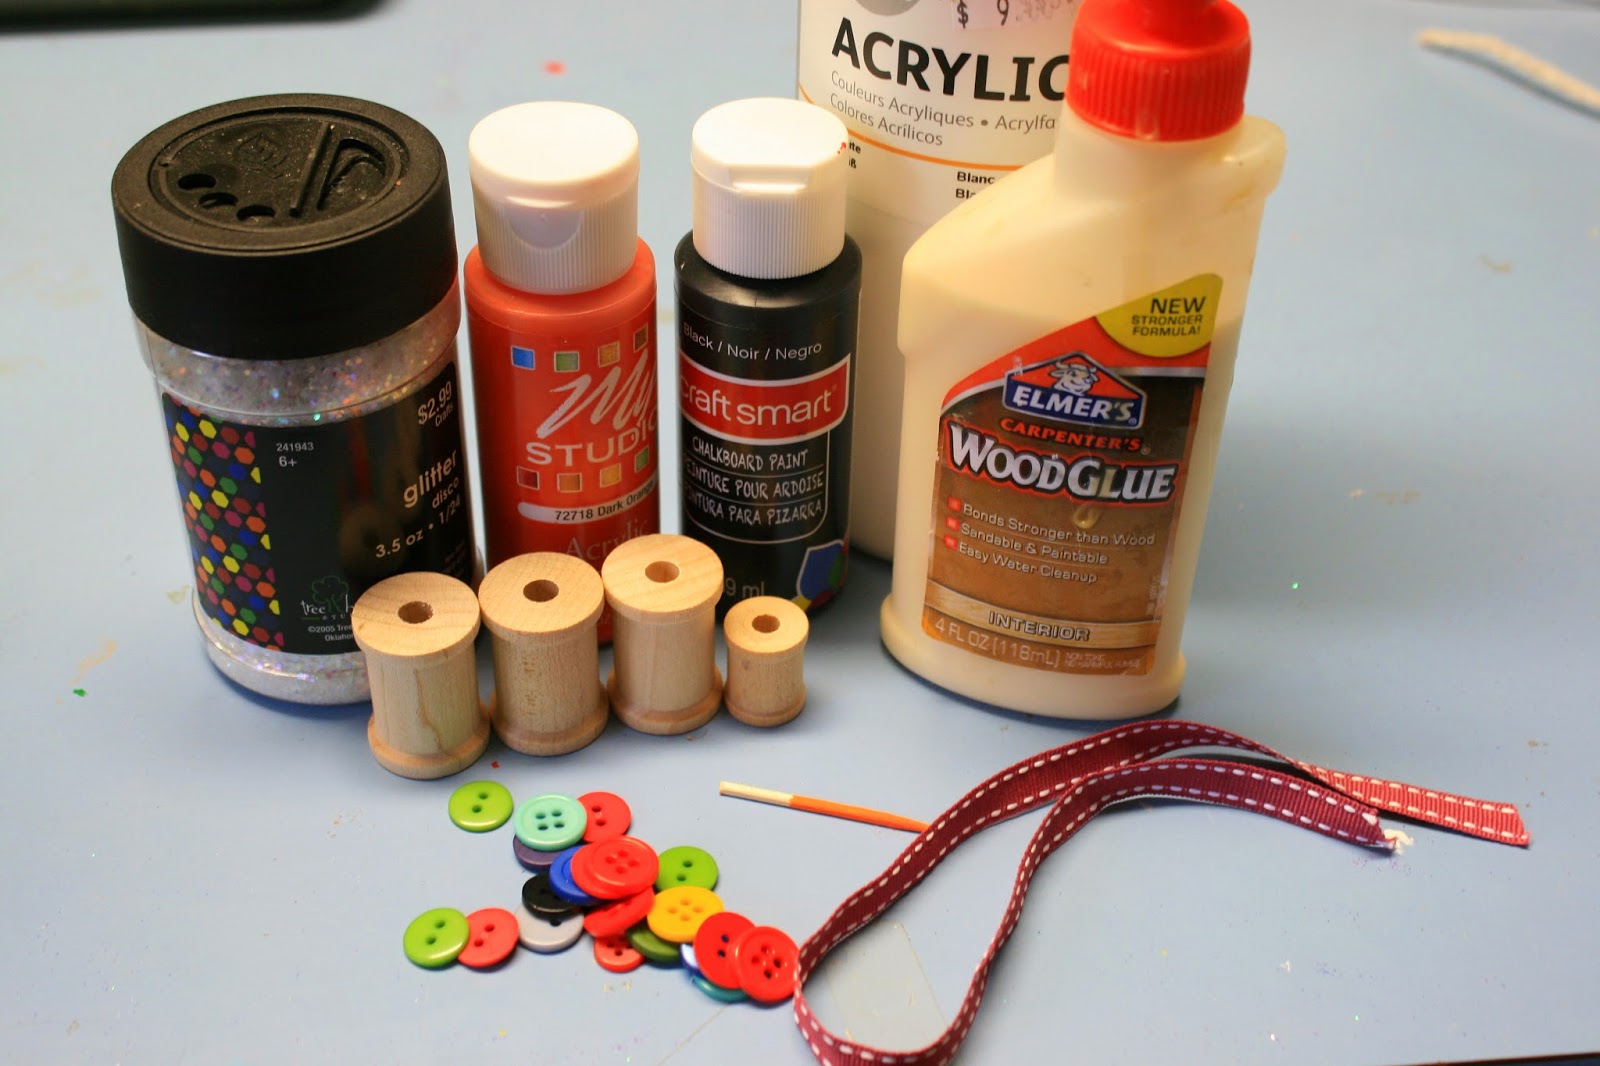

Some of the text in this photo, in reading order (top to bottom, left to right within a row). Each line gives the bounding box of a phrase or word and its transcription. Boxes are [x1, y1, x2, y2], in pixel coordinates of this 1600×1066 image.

[831, 17, 1070, 102] ACRYLIC
[830, 93, 943, 146] Colores Acrílicos
[831, 71, 1056, 135] Couleurs Acryliques Acrylfa
[1131, 314, 1203, 326] STRONGER
[1150, 296, 1207, 314] NEW
[683, 322, 714, 350] Black
[727, 343, 759, 360] Noir
[775, 343, 822, 361] Negro
[1132, 325, 1201, 337] FORMULA!
[417, 380, 453, 425] $2.99
[736, 389, 832, 426] smart
[1011, 385, 1136, 422] ELMER'S
[276, 442, 315, 452] 241943
[1000, 417, 1142, 451] CARPENTER'S
[278, 455, 298, 468] 6+
[692, 436, 809, 472] CHALKBOARD PAINT
[403, 449, 458, 508] glitter
[432, 476, 459, 509] disco
[735, 479, 769, 500] POUR
[773, 470, 824, 498] ARDOISE
[555, 507, 594, 521] 72718
[597, 500, 624, 518] Dark
[684, 485, 822, 526] INTURA PARA PIZARRA
[963, 503, 1156, 547] Bonds Stronger than Wood
[375, 538, 401, 558] 3.5
[406, 529, 424, 546] oz
[961, 523, 1109, 565] Sandable & Paintable
[959, 541, 1099, 584] Easy Water Cleanup
[724, 576, 737, 598] 9
[300, 600, 326, 616] tree
[324, 633, 354, 642] Oklaho
[935, 617, 946, 634] 4
[949, 623, 965, 644] FL
[968, 630, 991, 651] OZ
[988, 610, 1091, 642] INTERIOR
